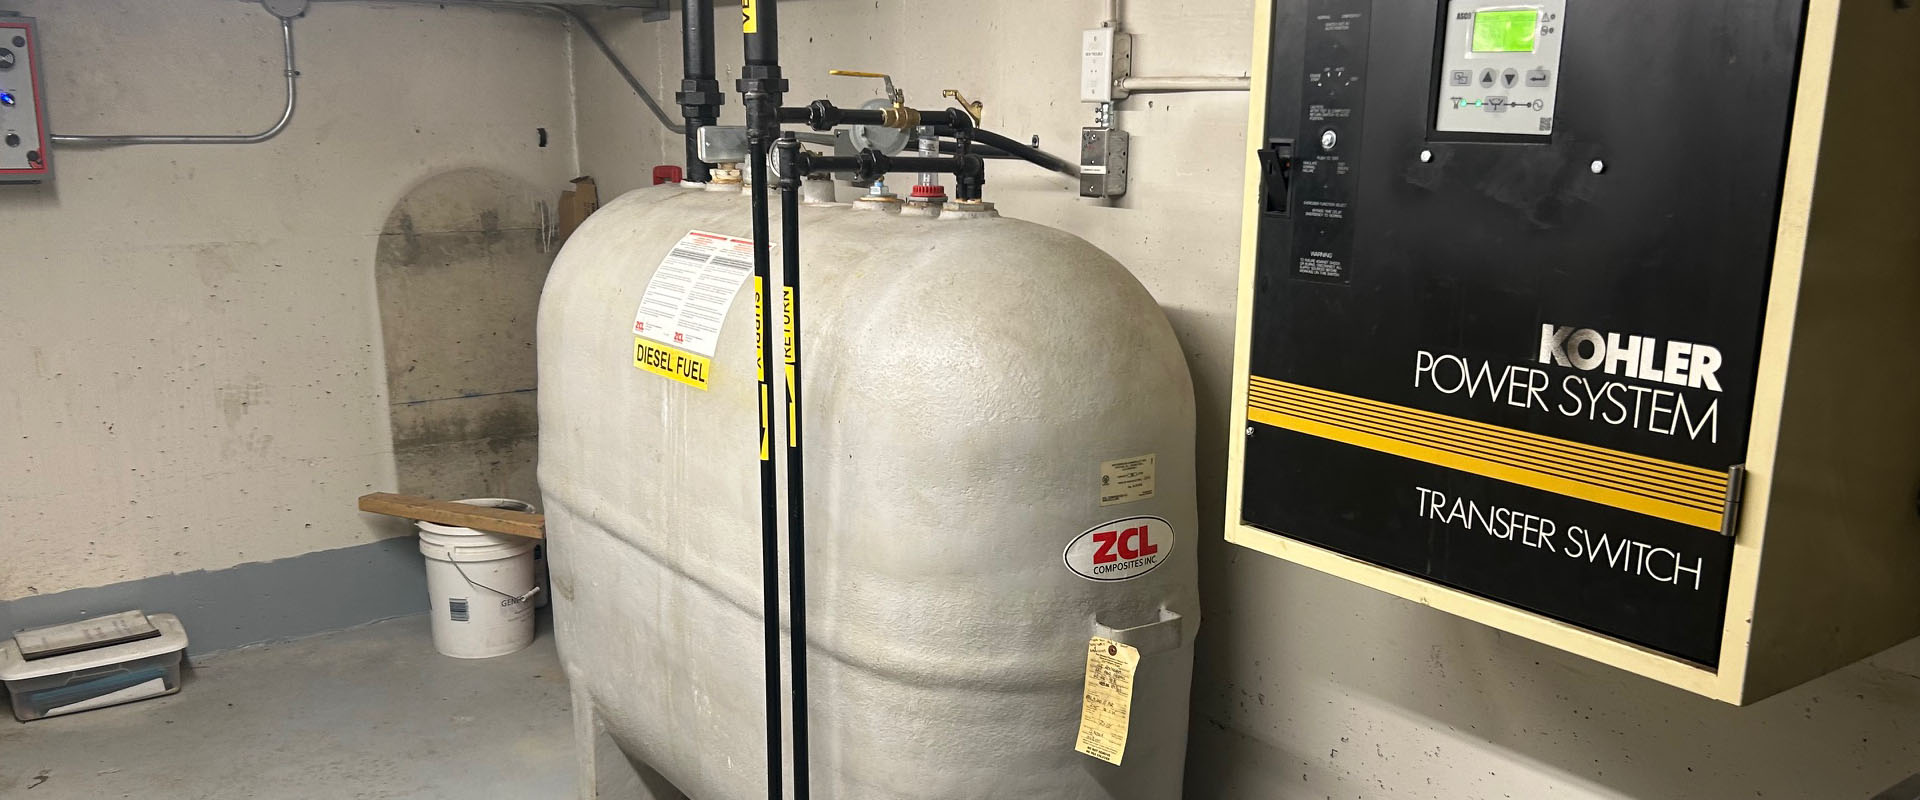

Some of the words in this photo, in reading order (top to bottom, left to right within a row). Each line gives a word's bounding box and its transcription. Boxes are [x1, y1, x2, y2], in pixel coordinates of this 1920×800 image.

[783, 290, 792, 359] RETURN
[1538, 323, 1723, 393] KOHLER
[636, 343, 674, 373] DIESEL
[676, 356, 706, 384] FUEL
[1414, 350, 1550, 412] POWER
[1558, 374, 1718, 444] SYSTEM
[1092, 525, 1158, 565] ZCL
[1093, 559, 1144, 575] COMPOSITES
[1415, 486, 1556, 553] TRANSFER
[1563, 525, 1703, 591] SWITCH
